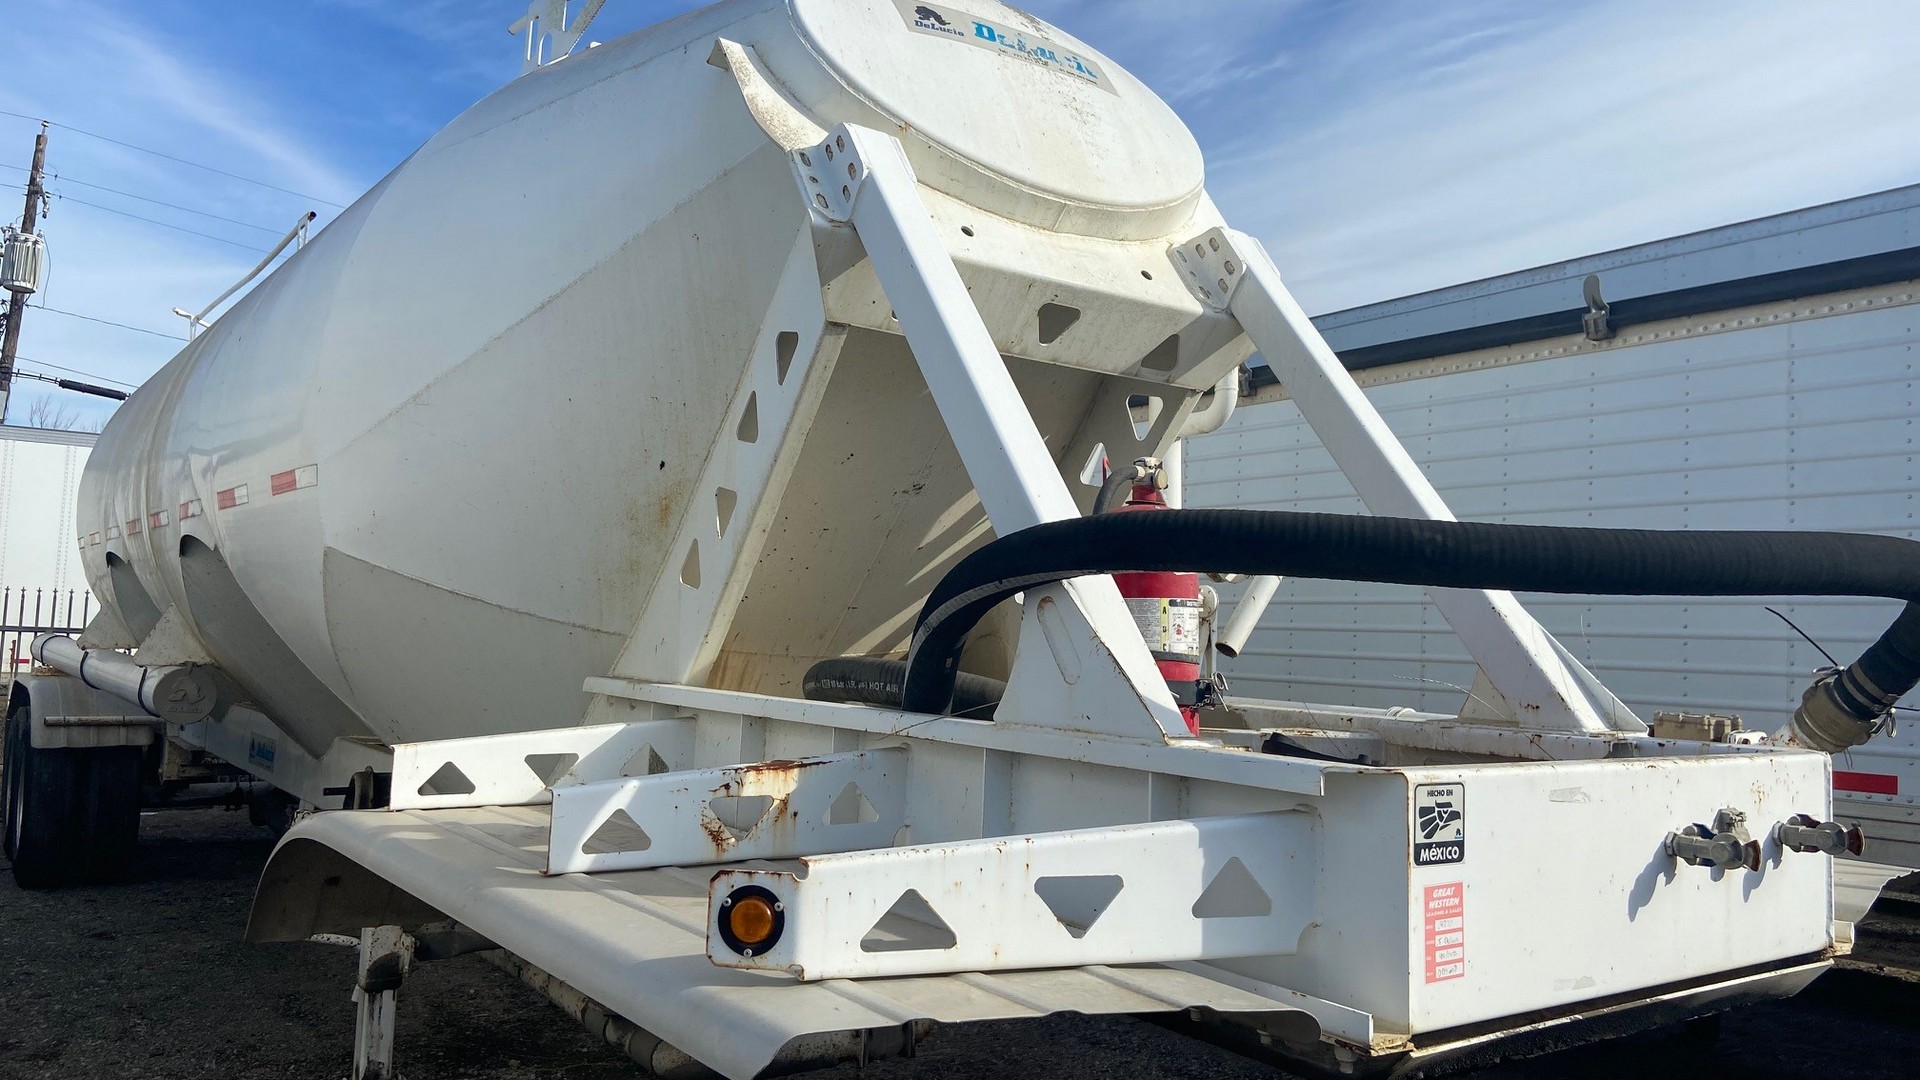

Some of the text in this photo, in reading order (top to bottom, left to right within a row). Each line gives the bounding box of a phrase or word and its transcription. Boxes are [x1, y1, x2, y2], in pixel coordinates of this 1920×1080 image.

[914, 19, 965, 37] DeLucio
[869, 681, 884, 691] HOT
[886, 683, 899, 693] AIR
[1427, 789, 1445, 797] HECHO
[1432, 886, 1455, 898] GREAT
[1428, 897, 1460, 909] WESTERN
